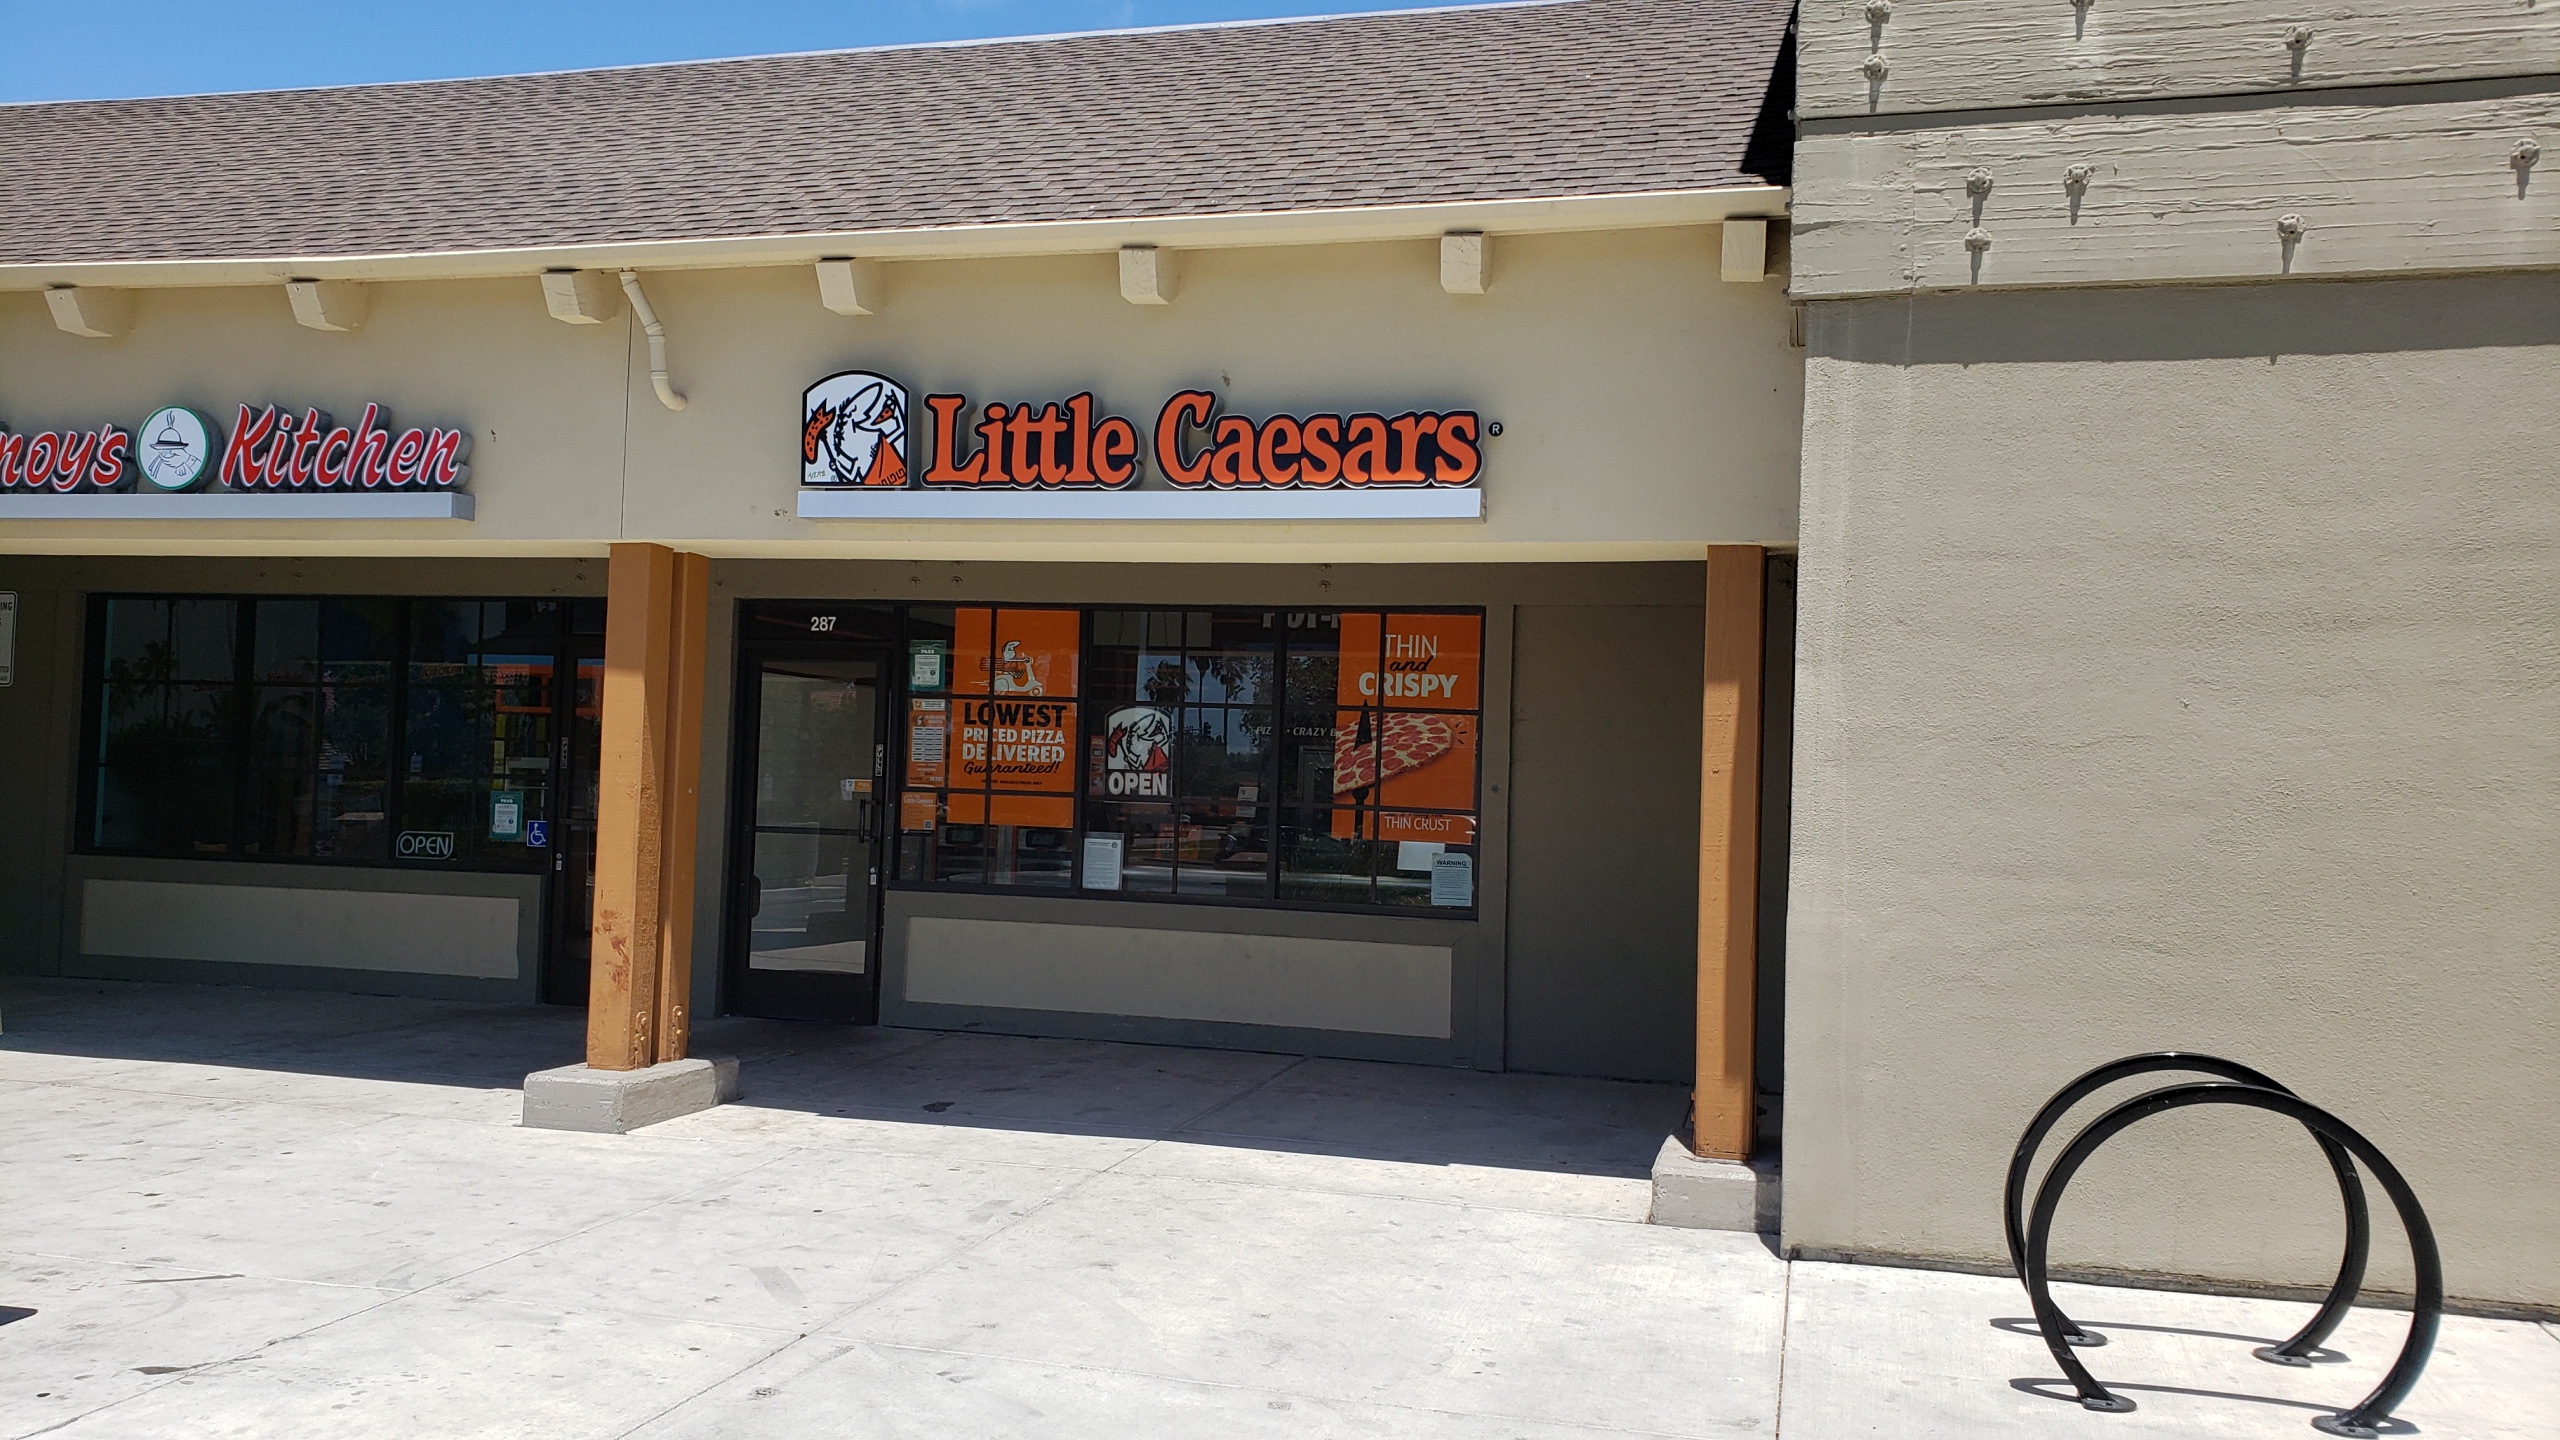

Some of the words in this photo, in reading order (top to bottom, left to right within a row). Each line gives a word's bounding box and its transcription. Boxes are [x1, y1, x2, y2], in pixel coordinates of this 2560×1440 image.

[221, 402, 461, 487] Kitchen
[922, 391, 1138, 488] Little
[1154, 389, 1480, 488] Caesars
[810, 616, 837, 631] 287
[1384, 634, 1438, 658] THIN
[1389, 655, 1434, 672] and
[1358, 672, 1459, 698] CRISPY
[964, 702, 1067, 727] LOWEST
[1020, 729, 1065, 744] PIZZA
[1293, 726, 1327, 736] CRAZY
[1108, 771, 1168, 796] OPEN
[1384, 816, 1411, 830] THIN
[1413, 817, 1451, 831] CRUST
[399, 835, 449, 855] OPEN
